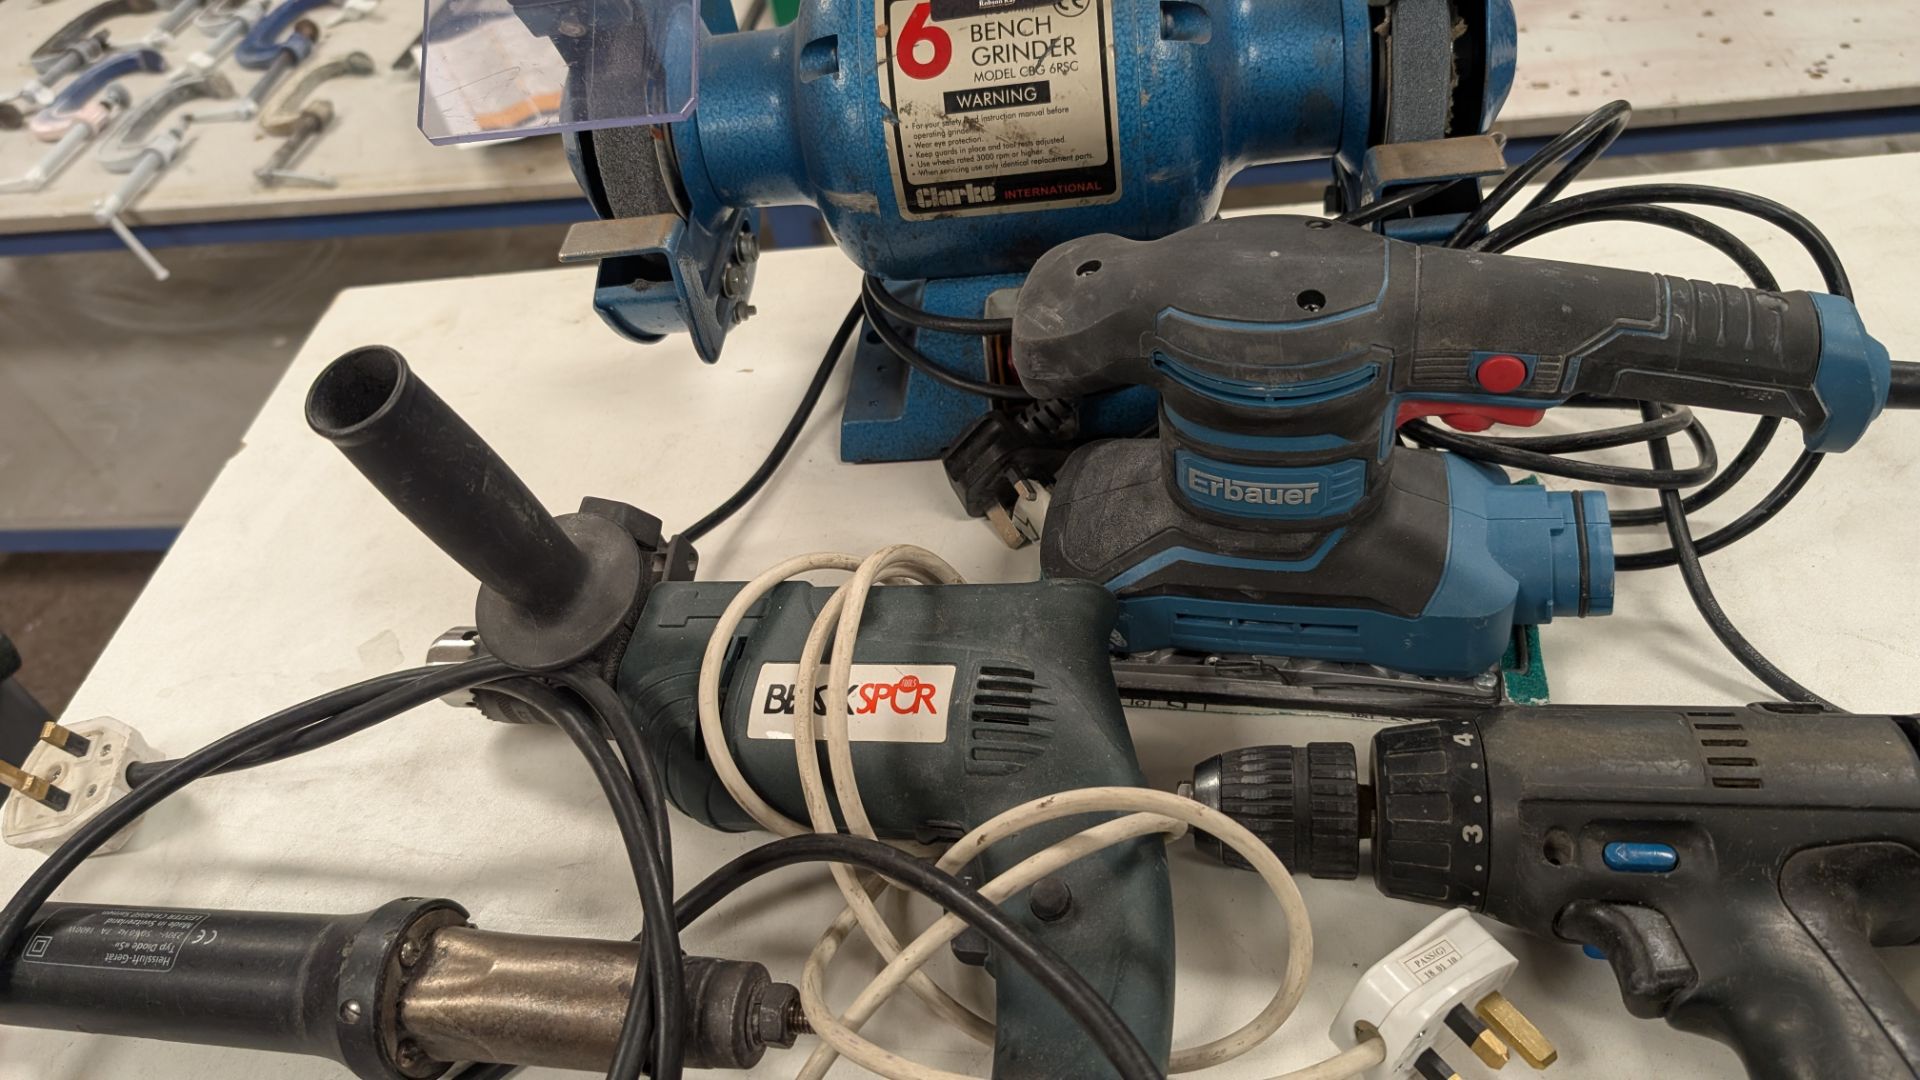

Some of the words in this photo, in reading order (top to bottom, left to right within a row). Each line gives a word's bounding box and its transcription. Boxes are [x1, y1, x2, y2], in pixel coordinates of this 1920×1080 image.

[970, 16, 1052, 42] BENCH
[896, 2, 953, 80] 6
[971, 36, 1077, 66] GRINDER
[974, 68, 1016, 82] MODEL
[1020, 64, 1045, 77] CBG
[956, 87, 1037, 108] WARNING
[912, 122, 923, 130] For
[924, 121, 940, 131] your
[942, 118, 962, 128] safety
[981, 111, 1016, 121] instruction
[1018, 109, 1045, 118] manual
[1046, 106, 1069, 115] before
[913, 129, 946, 139] operating
[914, 141, 933, 149] Wear
[934, 141, 946, 149] eye
[915, 150, 933, 159] Keep
[934, 148, 958, 158] guards
[960, 146, 966, 154] in
[967, 144, 986, 155] place
[988, 142, 1001, 151] and
[1018, 139, 1034, 148] rests
[917, 159, 930, 168] Use
[931, 158, 955, 167] wheels
[956, 155, 975, 164] rated
[976, 152, 994, 161] 3000
[996, 152, 1010, 161] rpm
[918, 168, 939, 177] When
[939, 165, 969, 176] servicing
[970, 163, 983, 171] use
[984, 162, 998, 171] only
[1000, 158, 1029, 168] identical
[1030, 153, 1074, 165] replacement
[915, 183, 996, 208] Clarke
[1004, 181, 1102, 199] INTERNATIONAL
[1188, 468, 1319, 505] Erbauer
[1453, 732, 1474, 747] 4
[1462, 824, 1483, 844] 3
[104, 917, 157, 928] Switzerland
[168, 921, 194, 929] Made
[131, 942, 158, 952] Diode
[159, 942, 175, 954] Typ
[1414, 946, 1447, 968] PASS(G)
[105, 952, 171, 966] Heissluft-Gerät
